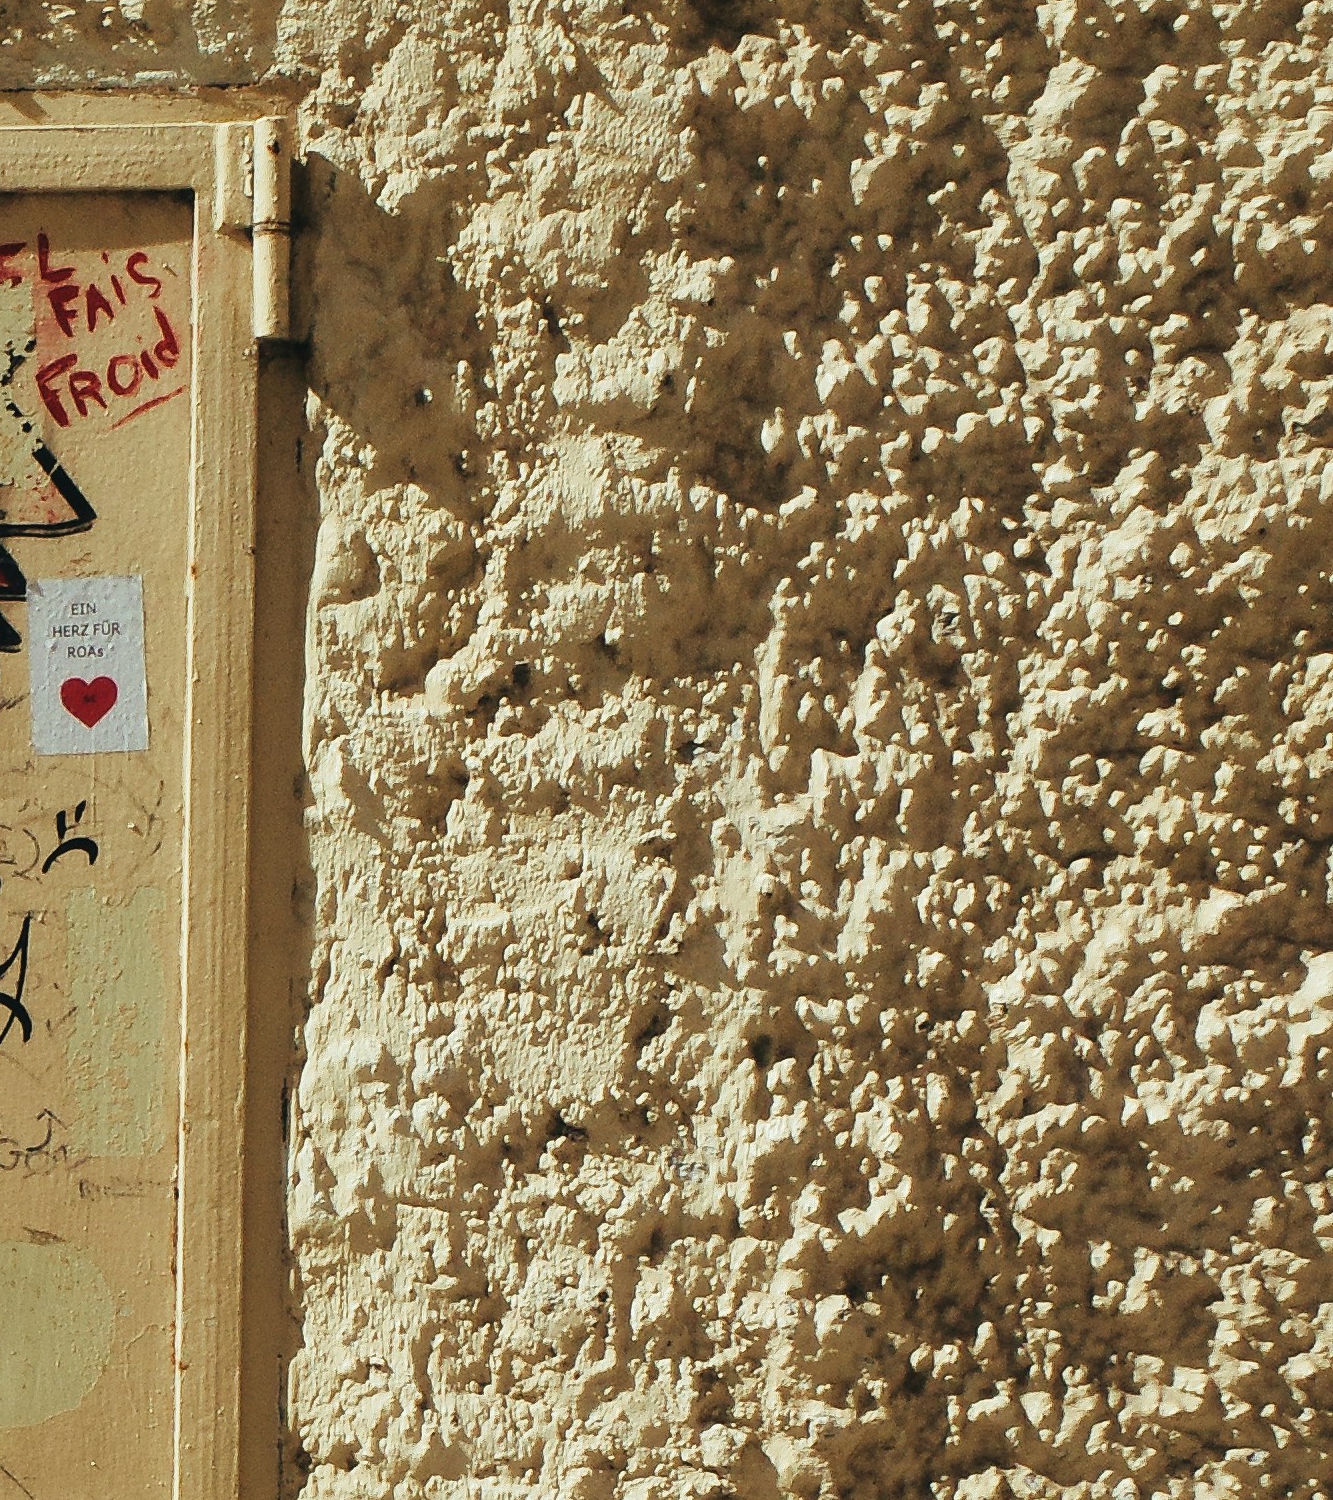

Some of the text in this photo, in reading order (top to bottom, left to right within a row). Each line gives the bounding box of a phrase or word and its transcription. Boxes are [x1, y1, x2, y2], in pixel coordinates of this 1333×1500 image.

[71, 603, 97, 615] EIN
[53, 619, 121, 638] HERZ FÜR
[67, 646, 104, 658] ROAs
